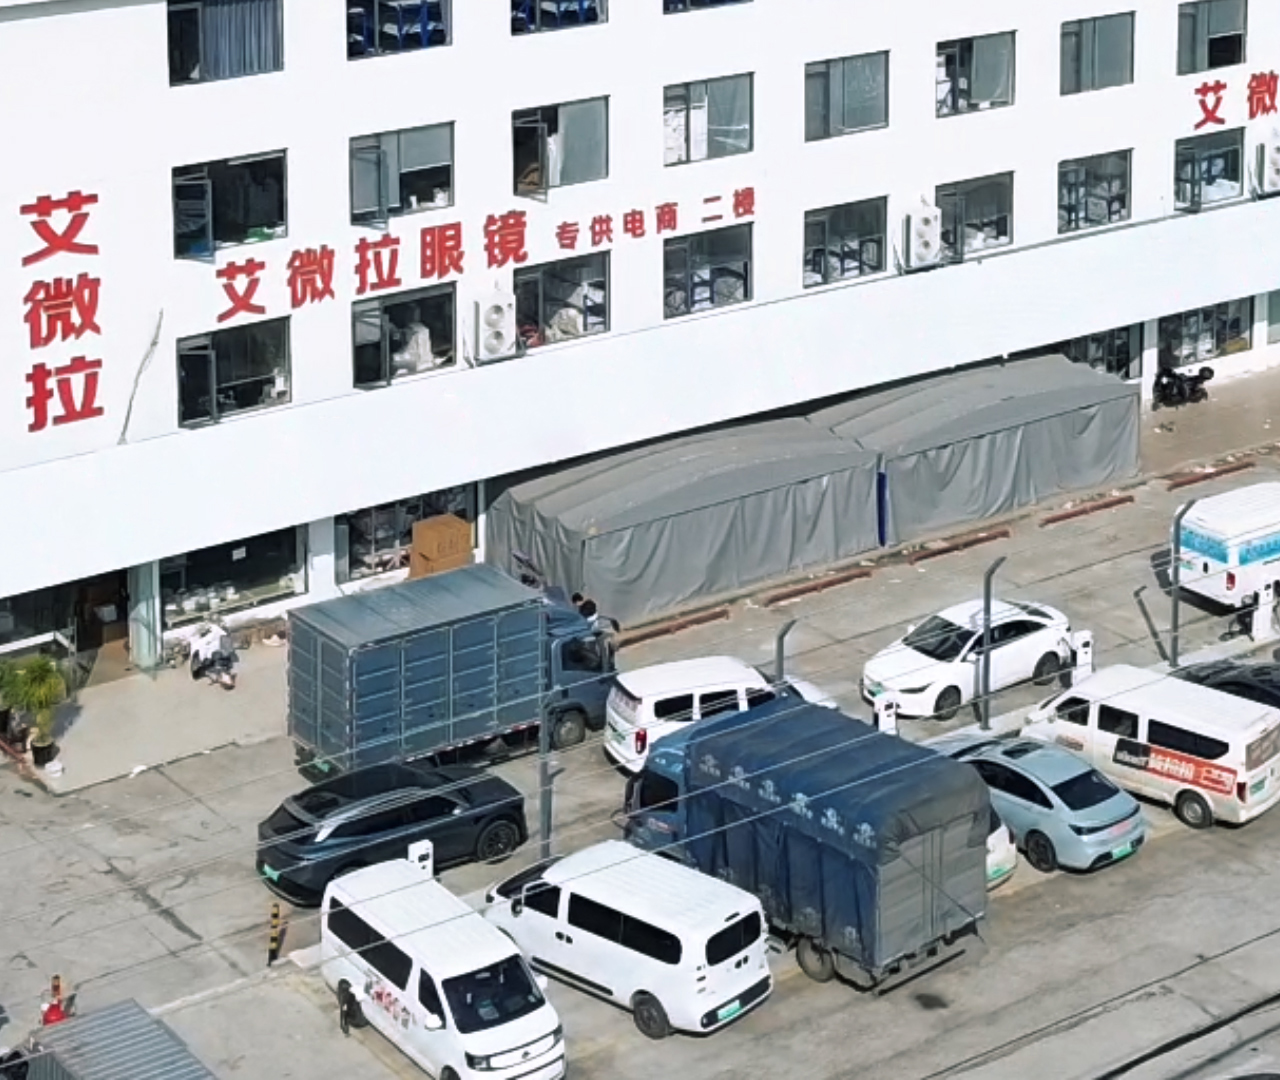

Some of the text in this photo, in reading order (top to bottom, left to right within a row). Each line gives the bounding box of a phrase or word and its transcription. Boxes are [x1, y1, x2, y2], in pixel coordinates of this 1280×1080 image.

[21, 191, 104, 433] 艾微拉
[216, 187, 756, 323] 艾微拉眼镜 专供电商 二楼
